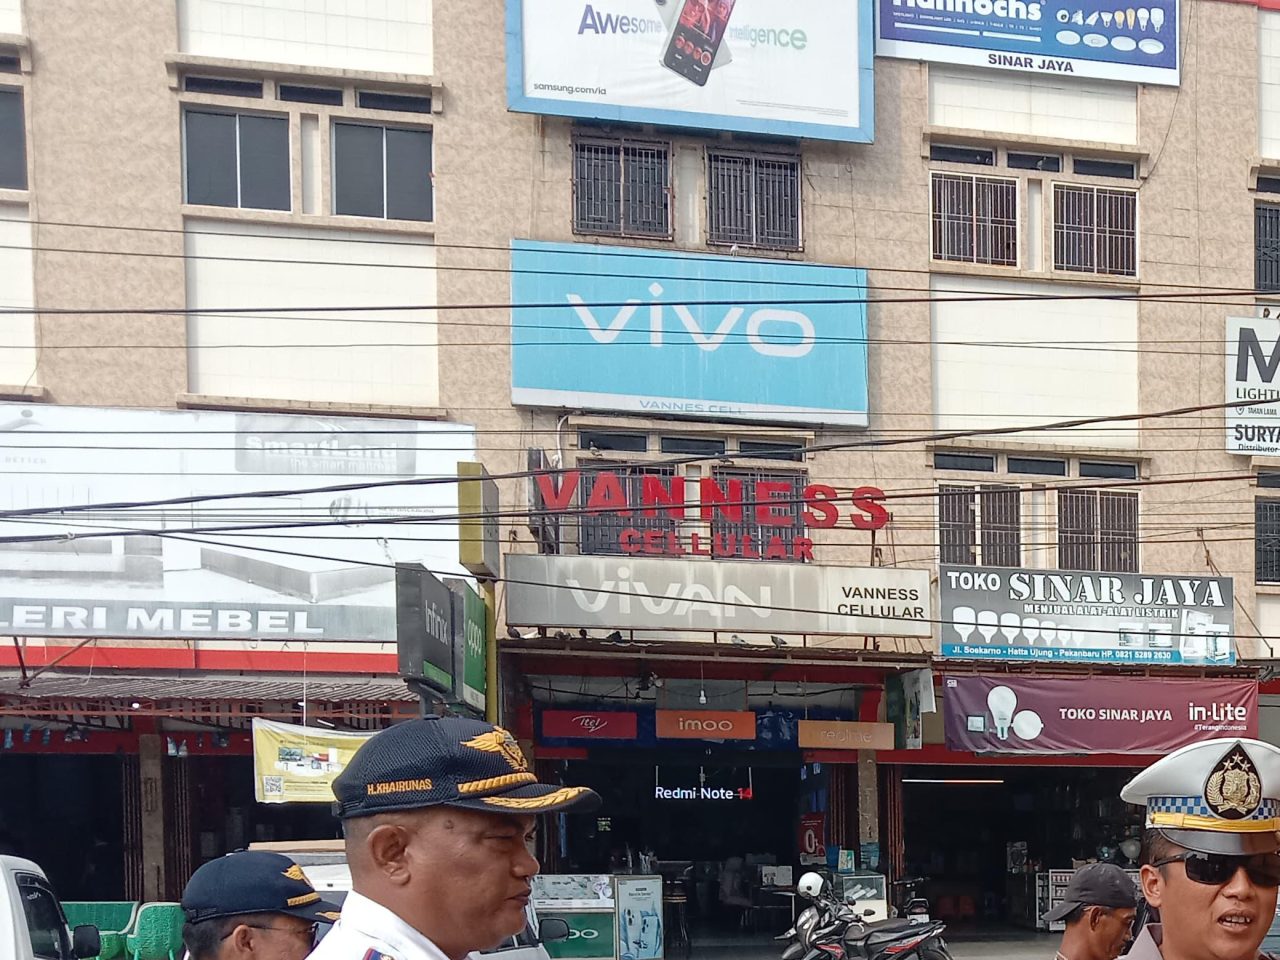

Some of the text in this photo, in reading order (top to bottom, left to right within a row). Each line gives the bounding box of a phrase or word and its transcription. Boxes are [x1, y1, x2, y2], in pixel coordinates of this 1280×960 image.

[893, 0, 1041, 21] annochs
[577, 4, 662, 35] Awesome
[988, 53, 1074, 73] SINAR JAYA
[533, 82, 607, 96] samsung.com/ia
[566, 282, 816, 358] vivo
[639, 400, 704, 413] VANNES
[1238, 444, 1278, 453] Distributor
[535, 470, 889, 530] VANNESS
[619, 528, 815, 561] CELLULAR
[841, 586, 919, 602] VANNESS
[946, 571, 1225, 607] TOKO SINAR JAYA
[837, 603, 925, 619] CELLULAR
[1023, 603, 1179, 618] MENJUAL ALAT-ALAT LISTRIK
[0, 605, 325, 635] ERI MEBEL
[425, 599, 449, 646] Infinix
[1029, 649, 1053, 659] Ujung
[1059, 708, 1173, 723] TOKO SINAR JAYA
[678, 717, 733, 731] imoo
[655, 786, 697, 799] Redmi
[700, 787, 734, 800] Note
